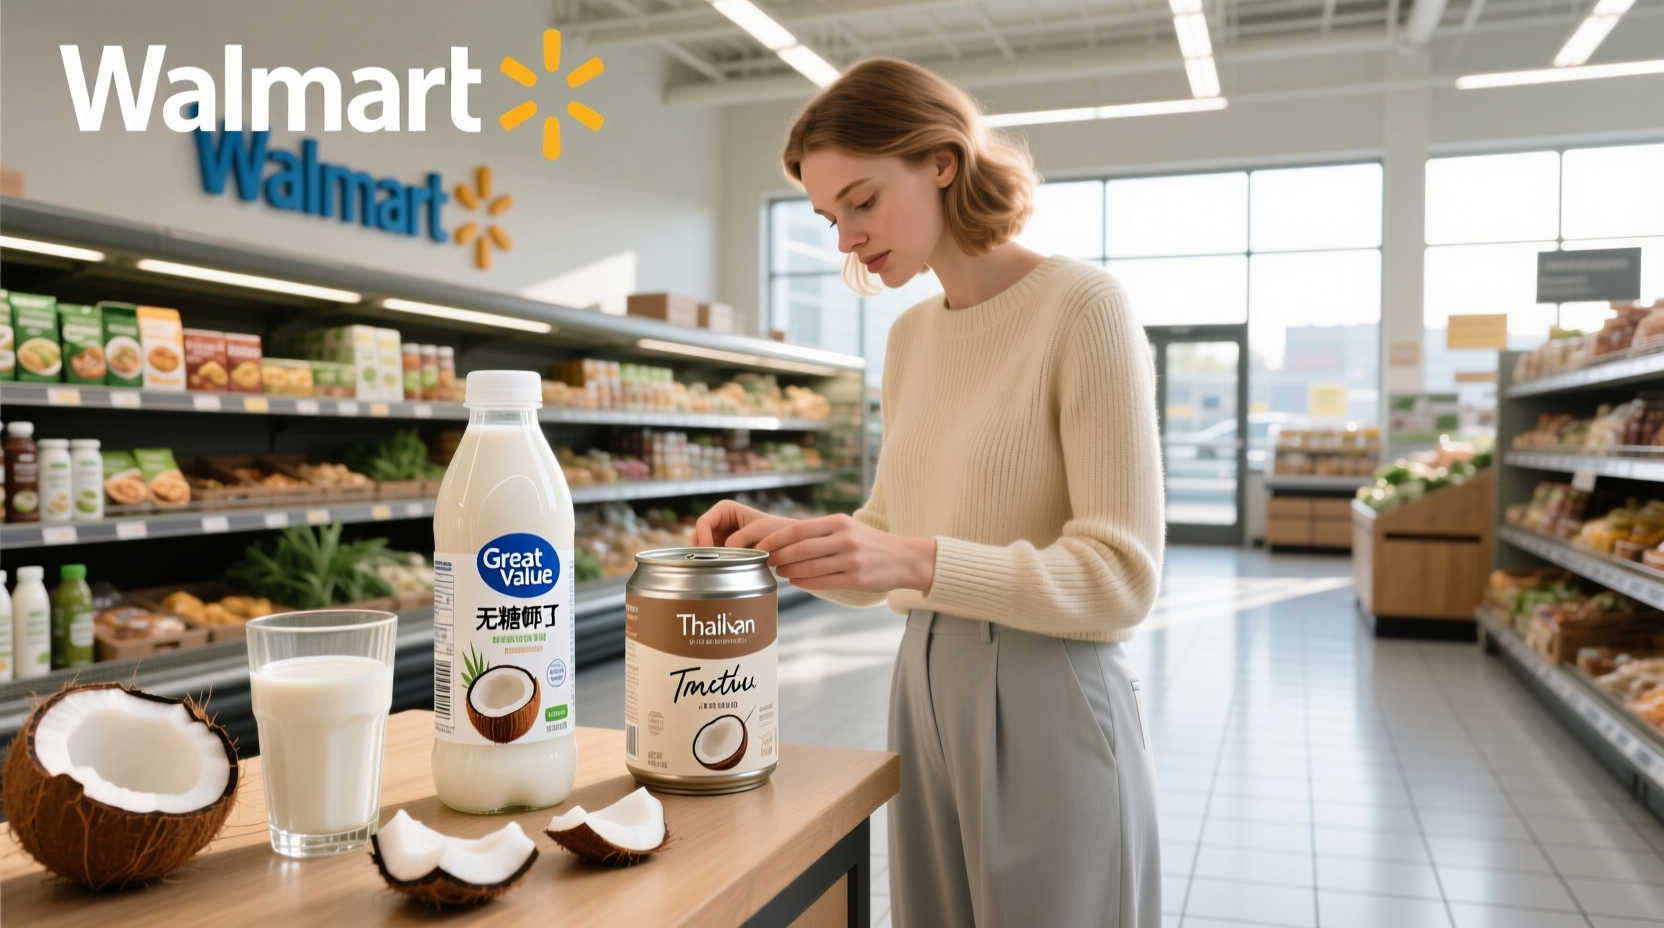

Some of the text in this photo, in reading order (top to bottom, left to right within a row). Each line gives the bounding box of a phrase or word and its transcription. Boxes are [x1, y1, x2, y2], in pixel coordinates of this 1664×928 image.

[190, 103, 449, 243] Walmart
[482, 547, 543, 569] Great
[500, 567, 553, 587] Value
